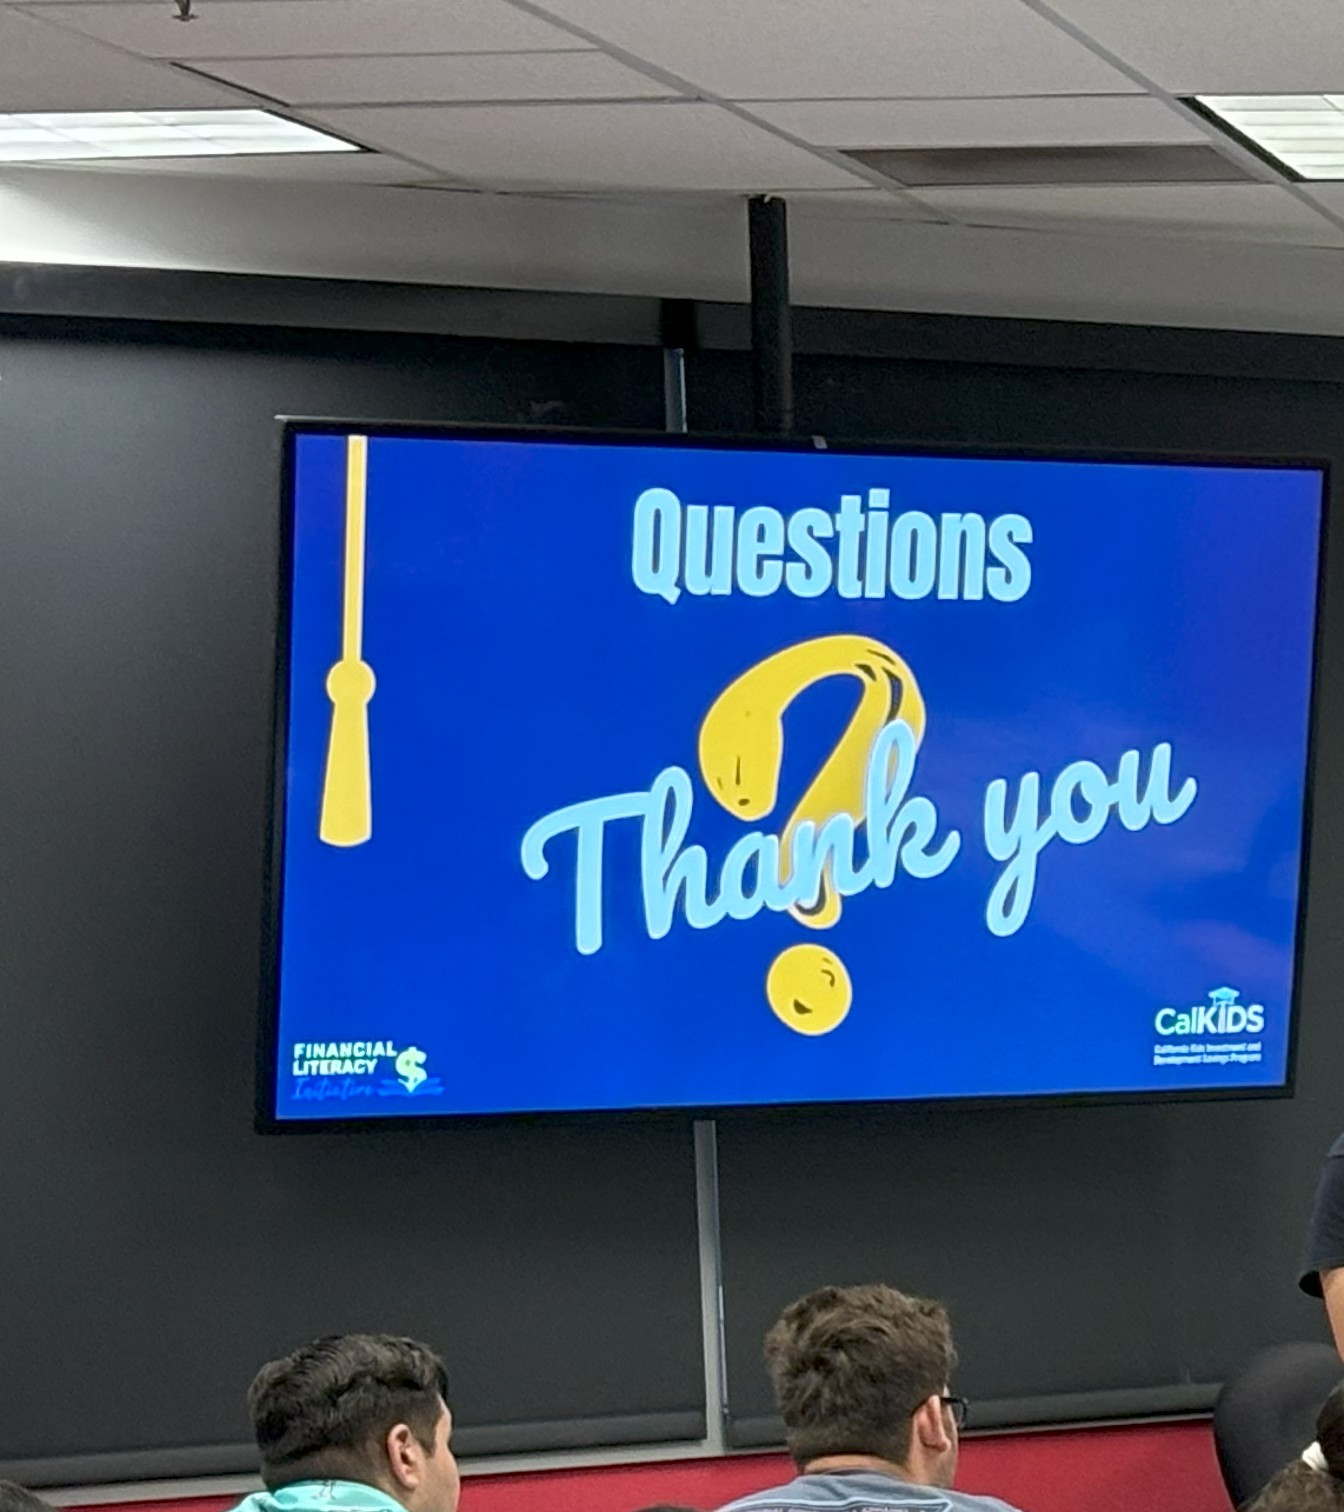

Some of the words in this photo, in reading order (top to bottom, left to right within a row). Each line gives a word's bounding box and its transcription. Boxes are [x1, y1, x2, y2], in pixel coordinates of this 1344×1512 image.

[631, 487, 1033, 605] Questions
[521, 718, 961, 956] Thank
[983, 742, 1198, 937] you
[1154, 1000, 1265, 1036] CalKIDS
[292, 1058, 378, 1077] LITERACY
[293, 1040, 398, 1059] FINANCIAL
